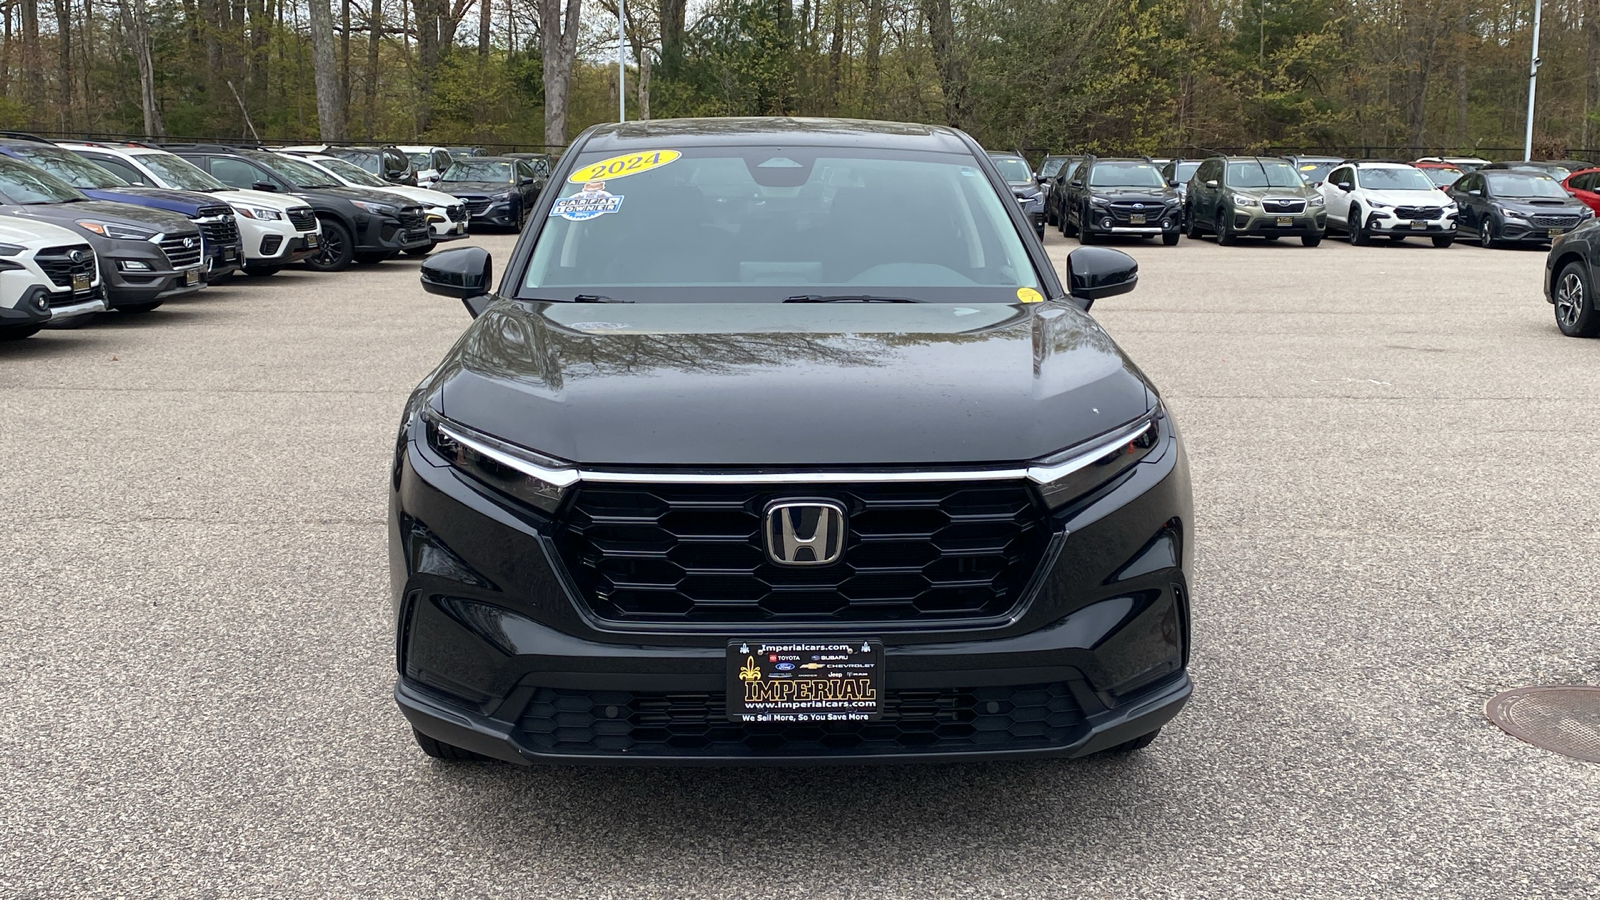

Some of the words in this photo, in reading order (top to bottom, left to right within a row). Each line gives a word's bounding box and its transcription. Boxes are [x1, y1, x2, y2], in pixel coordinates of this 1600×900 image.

[590, 153, 662, 179] 2024
[558, 198, 618, 206] CARFAX
[565, 204, 615, 212] OWNER
[761, 644, 849, 653] Imperialcars.com
[744, 679, 877, 701] IMPERIAL
[774, 714, 796, 722] More,
[827, 713, 847, 721] Save
